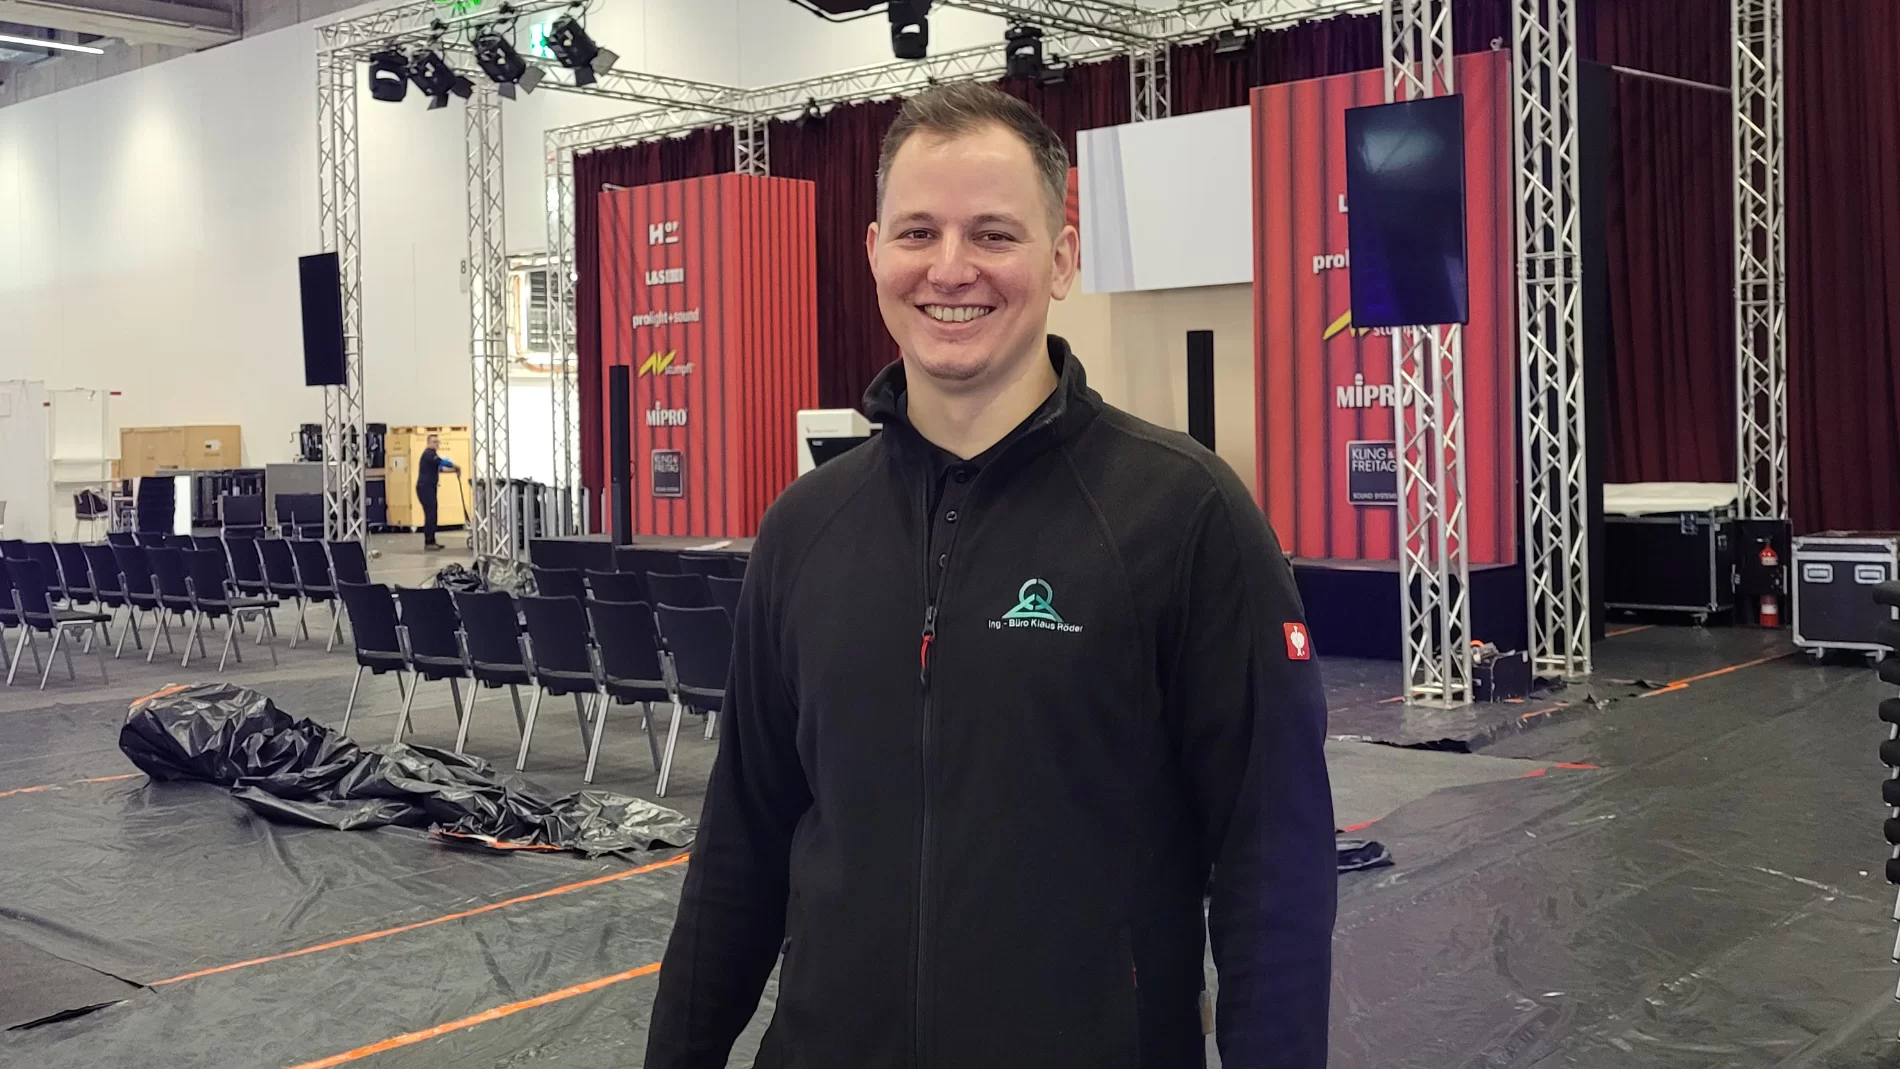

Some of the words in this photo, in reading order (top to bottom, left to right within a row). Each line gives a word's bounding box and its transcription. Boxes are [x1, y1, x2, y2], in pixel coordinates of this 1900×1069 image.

[460, 260, 467, 275] 8
[1351, 459, 1397, 472] FREITAG
[1009, 618, 1029, 627] Büro
[1030, 618, 1056, 630] Klaus
[1057, 622, 1084, 632] Röder
